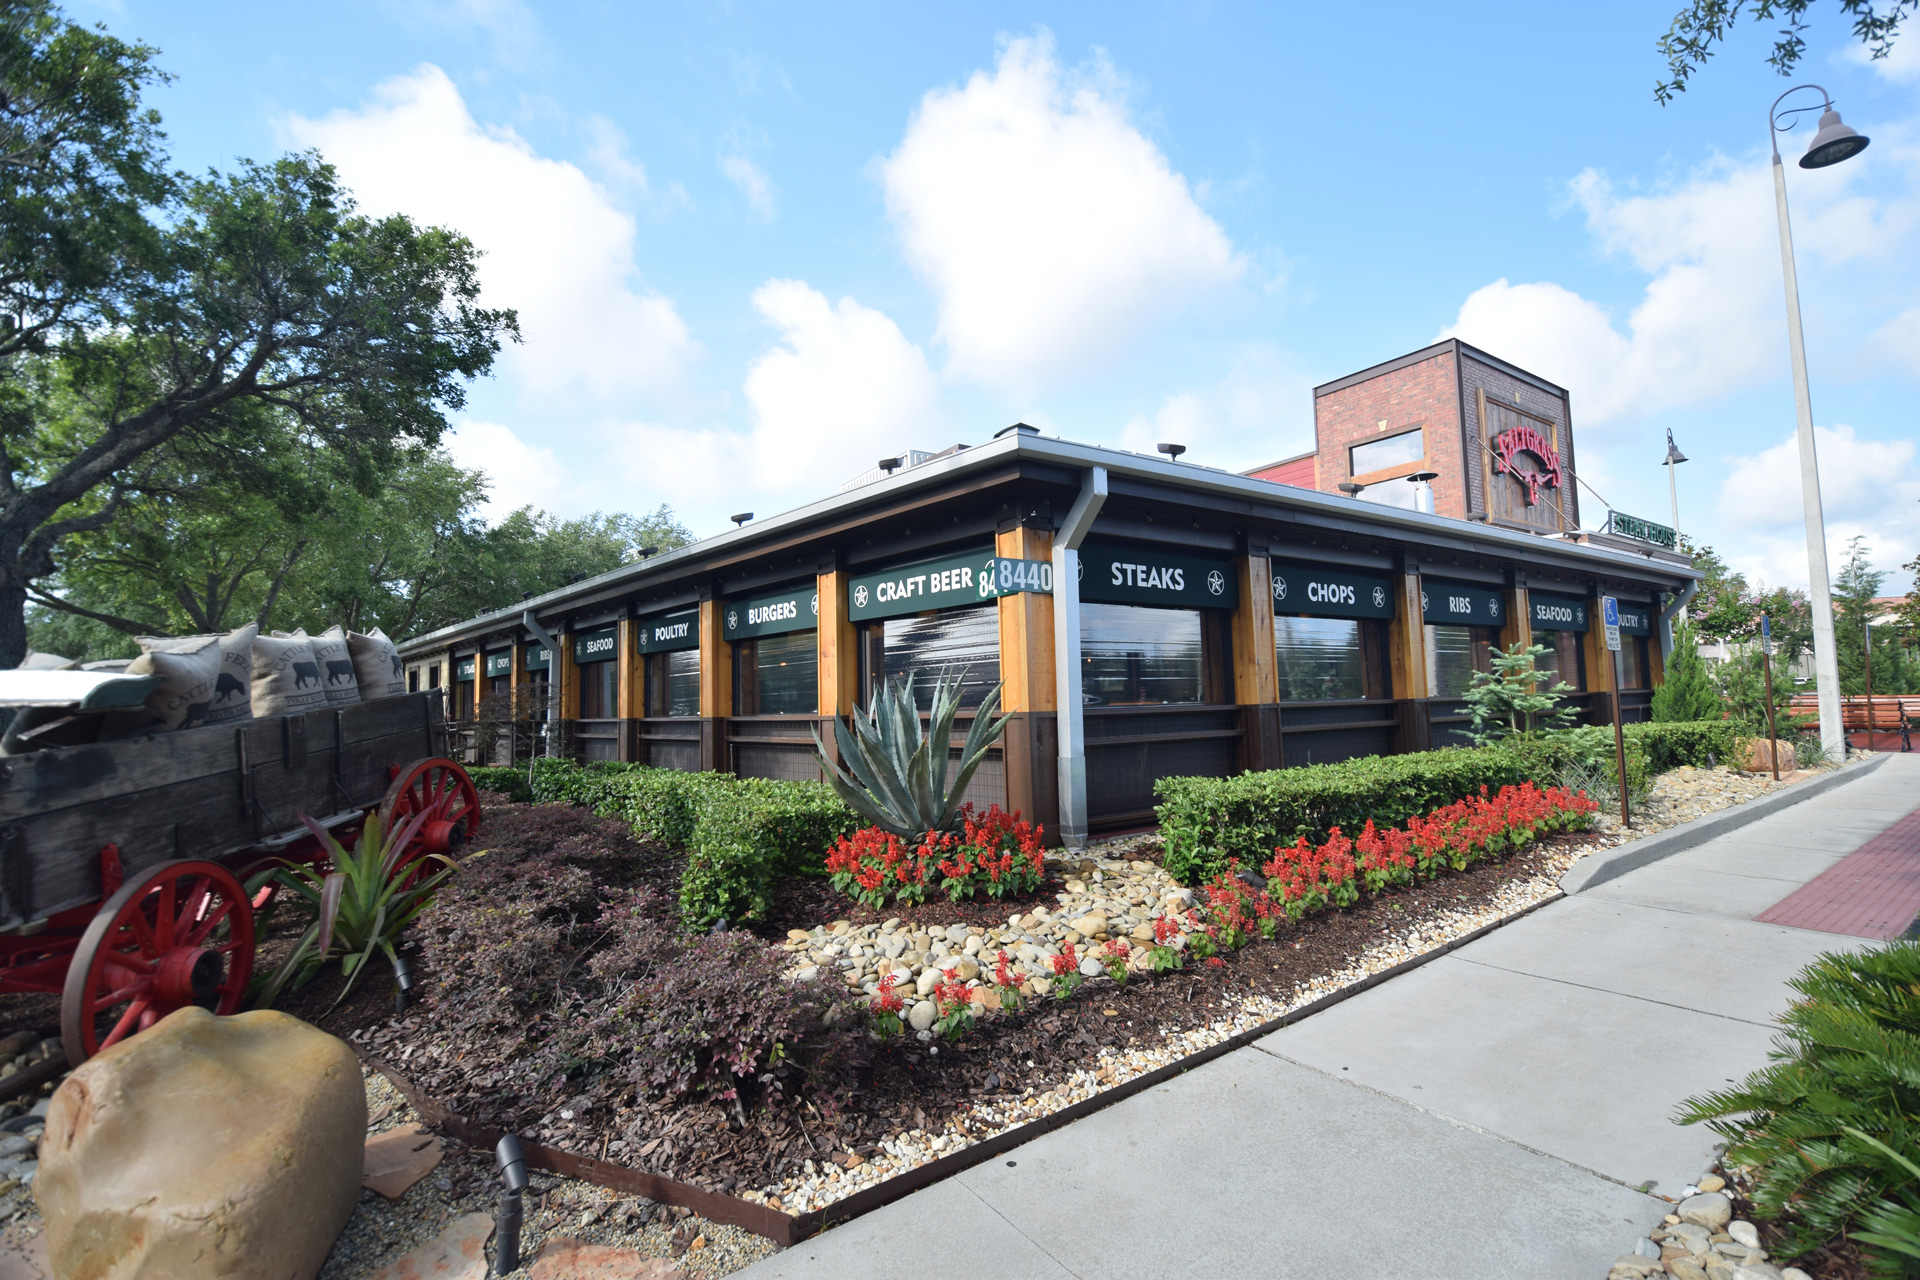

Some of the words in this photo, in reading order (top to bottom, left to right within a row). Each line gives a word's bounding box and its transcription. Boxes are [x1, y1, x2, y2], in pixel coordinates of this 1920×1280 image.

[1498, 426, 1563, 488] SALTGRASS
[1615, 514, 1648, 538] STEAK
[1650, 524, 1677, 546] HOUSE
[876, 575, 927, 603] CRAFT
[930, 567, 973, 594] BEER
[978, 570, 998, 598] 84
[999, 560, 1053, 591] 8440
[1111, 561, 1185, 591] STEAKS
[1307, 581, 1356, 605] CHOPS
[1448, 596, 1472, 614] RIBS
[748, 600, 797, 625] BURGERS
[1536, 604, 1573, 622] SEAFOOD
[1617, 613, 1639, 628] OULTRY
[655, 622, 689, 642] POULTRY
[315, 643, 343, 664] ATTLE
[540, 650, 550, 661] RIBS
[586, 637, 614, 654] SEAFOOD
[274, 645, 307, 672] CATTLE
[497, 657, 510, 669] CHOPS
